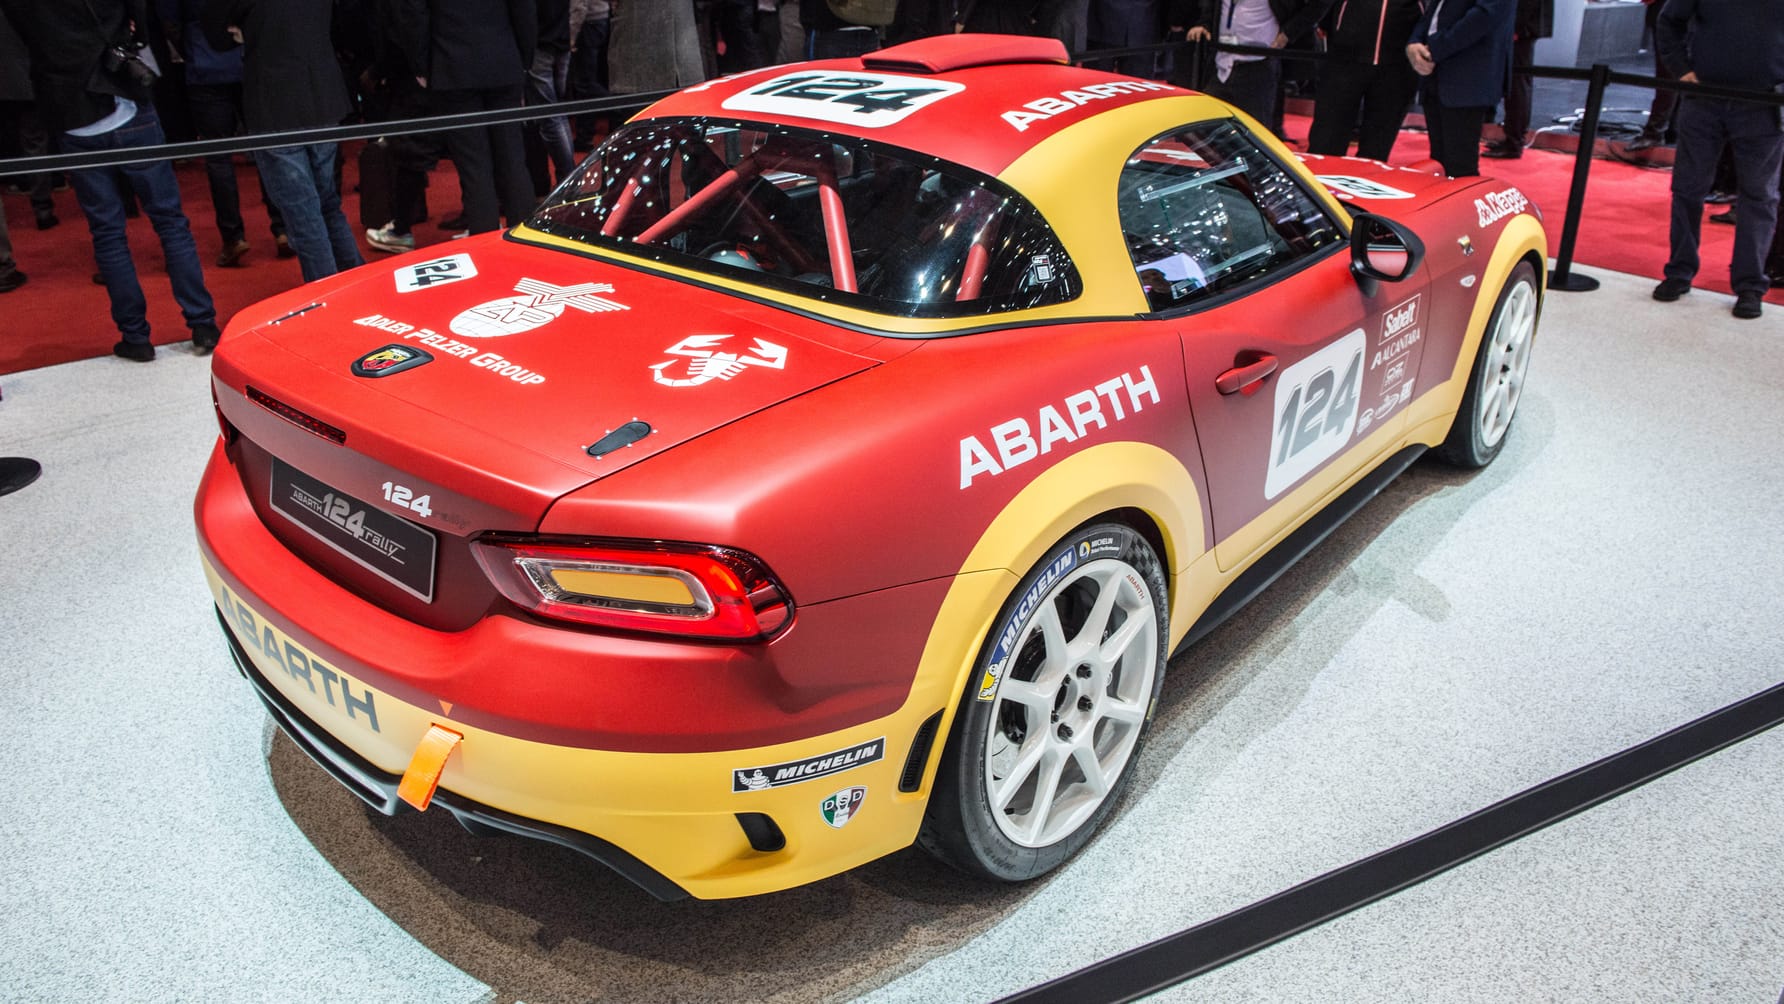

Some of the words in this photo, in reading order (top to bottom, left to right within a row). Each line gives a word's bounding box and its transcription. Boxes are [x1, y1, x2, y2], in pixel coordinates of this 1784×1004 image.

[751, 75, 949, 114] 124
[1000, 81, 1176, 132] ABARTH
[410, 259, 463, 286] 124
[1384, 302, 1416, 337] Sabelt
[353, 314, 415, 335] ADLER
[404, 328, 478, 359] PELZER
[469, 352, 546, 385] GROUP
[959, 364, 1161, 490] ABARTH
[1276, 346, 1363, 468] 124
[292, 490, 323, 513] ABARTH
[322, 493, 366, 539] 124
[364, 532, 400, 557] rally
[382, 481, 432, 518] 124
[1000, 550, 1074, 652] MICHELIN
[1126, 574, 1145, 600] ABARTH
[221, 585, 381, 734] ABARTH
[775, 744, 878, 781] MICHELIN
